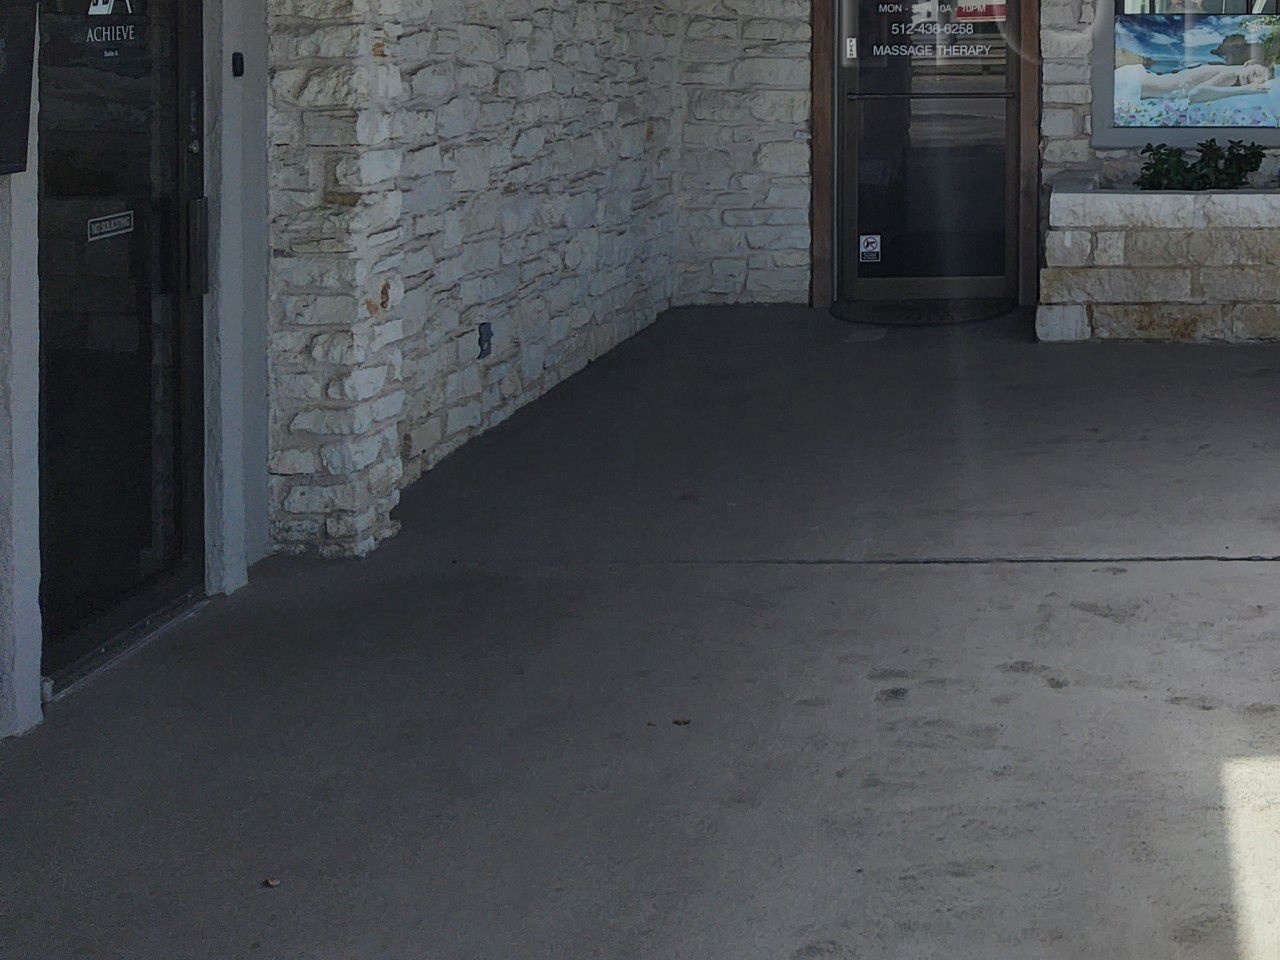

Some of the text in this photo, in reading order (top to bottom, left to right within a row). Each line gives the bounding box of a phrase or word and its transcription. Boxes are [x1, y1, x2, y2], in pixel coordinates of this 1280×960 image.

[878, 3, 903, 13] MON
[961, 3, 986, 13] 10PM
[86, 25, 135, 42] ACHIEVE
[891, 23, 974, 35] 512-436-6258
[872, 44, 992, 56] MASSAGE THERAPY
